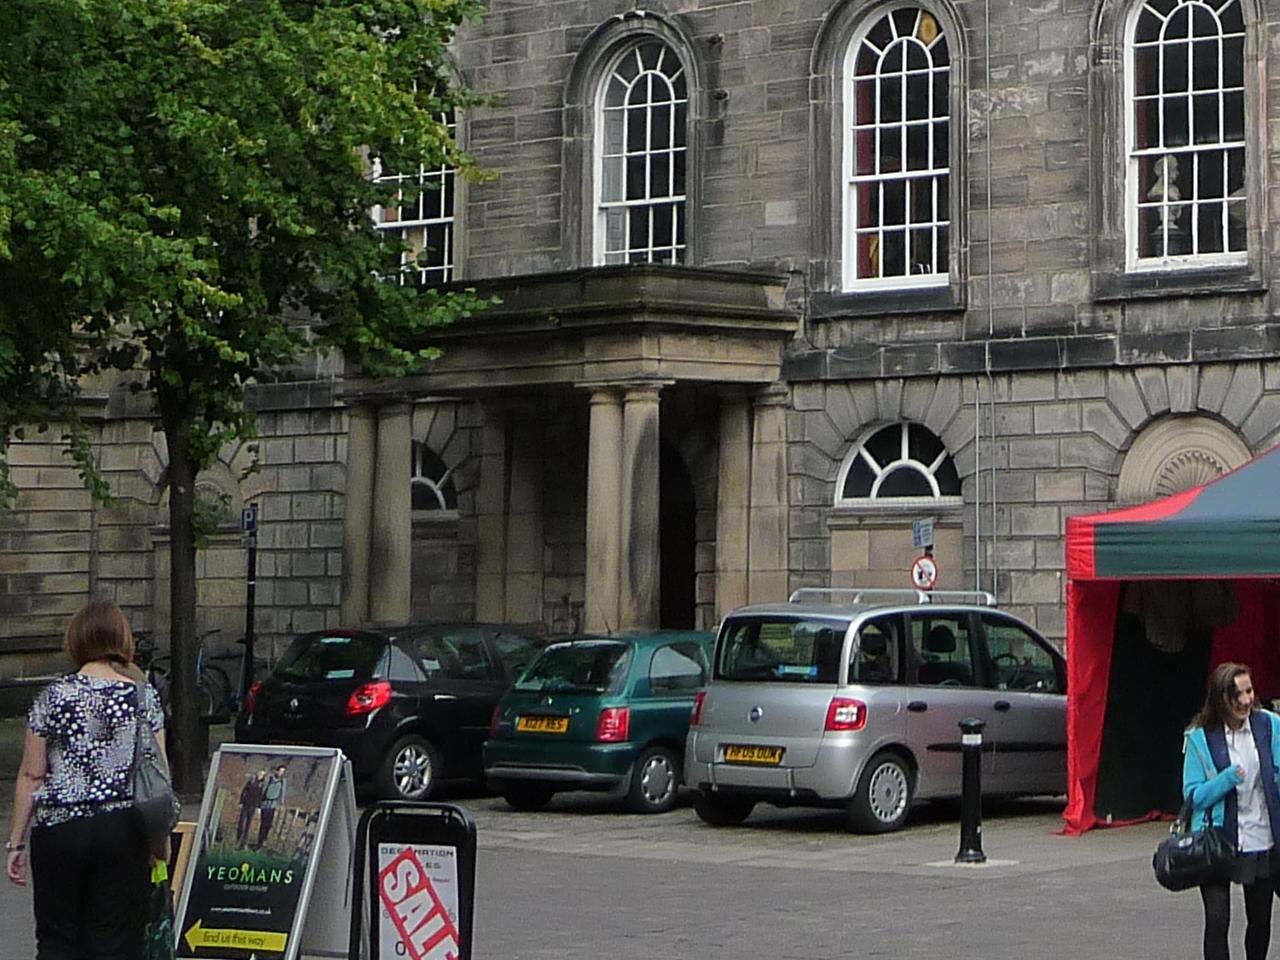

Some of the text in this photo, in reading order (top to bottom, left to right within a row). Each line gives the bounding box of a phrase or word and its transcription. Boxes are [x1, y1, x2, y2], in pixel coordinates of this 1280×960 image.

[243, 509, 254, 530] P
[206, 863, 295, 885] YEOMANS
[221, 933, 231, 942] us
[248, 937, 265, 948] way
